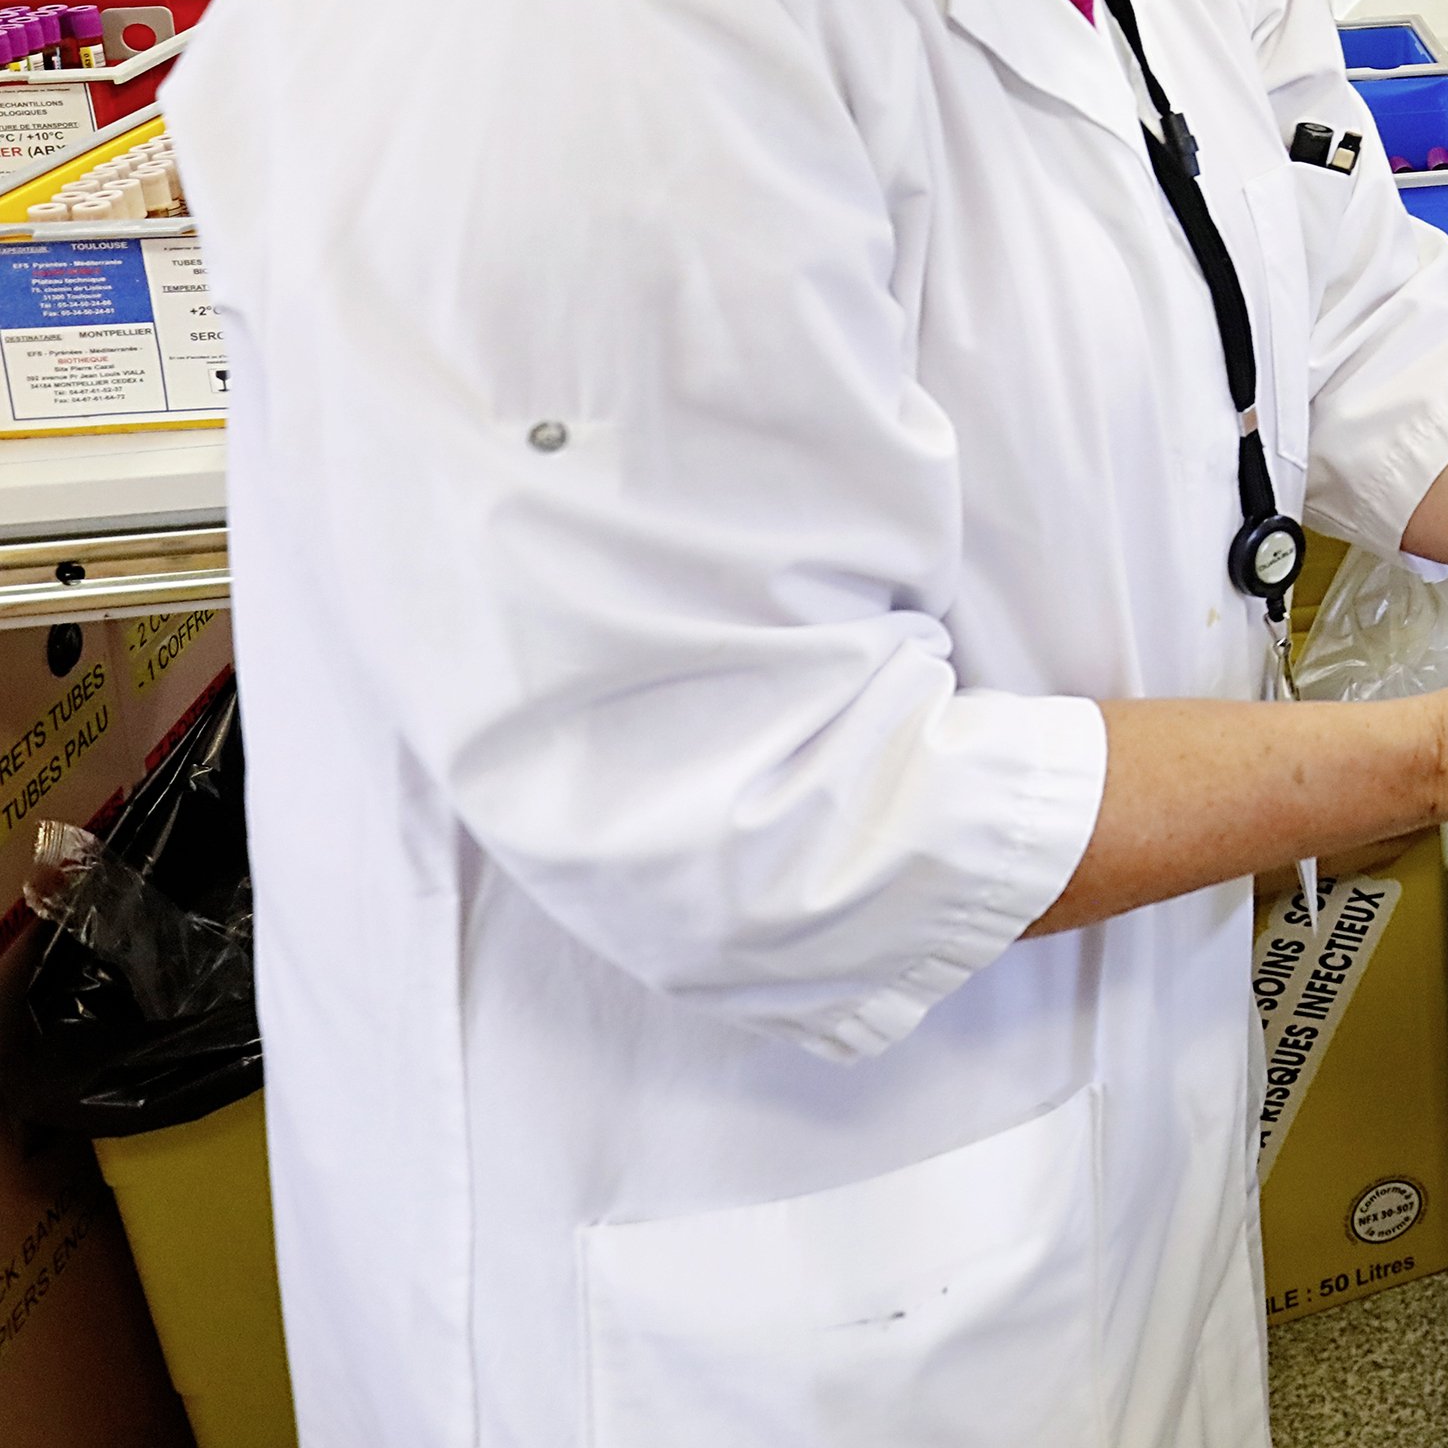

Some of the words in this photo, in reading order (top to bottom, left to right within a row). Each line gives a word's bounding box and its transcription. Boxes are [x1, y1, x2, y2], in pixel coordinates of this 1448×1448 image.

[20, 123, 31, 131] DE
[32, 121, 79, 130] TRANSPORT
[0, 133, 16, 142] °C
[26, 131, 64, 141] +10°C
[0, 146, 23, 157] ER
[70, 241, 129, 251] TOULOUSE
[171, 258, 203, 267] TUBES
[79, 327, 153, 339] MONTPELLIER
[57, 355, 110, 365] BIOTHEQUE
[80, 372, 98, 380] Jean
[100, 370, 121, 379] Louis
[122, 369, 146, 377] VIALA
[53, 380, 110, 389] MONTPELLIER
[111, 377, 137, 386] CEDEX
[48, 663, 105, 731] TUBES
[2, 755, 62, 830] TUBES
[64, 705, 109, 768] PALU
[1253, 938, 1305, 1011] SOINS
[1260, 1024, 1318, 1123] RISQUES
[1293, 887, 1385, 1021] INFECTIEUX
[1360, 1186, 1408, 1214] Conforme
[1377, 1215, 1411, 1238] norme
[1319, 1273, 1350, 1297] 50
[1355, 1256, 1415, 1287] Litres
